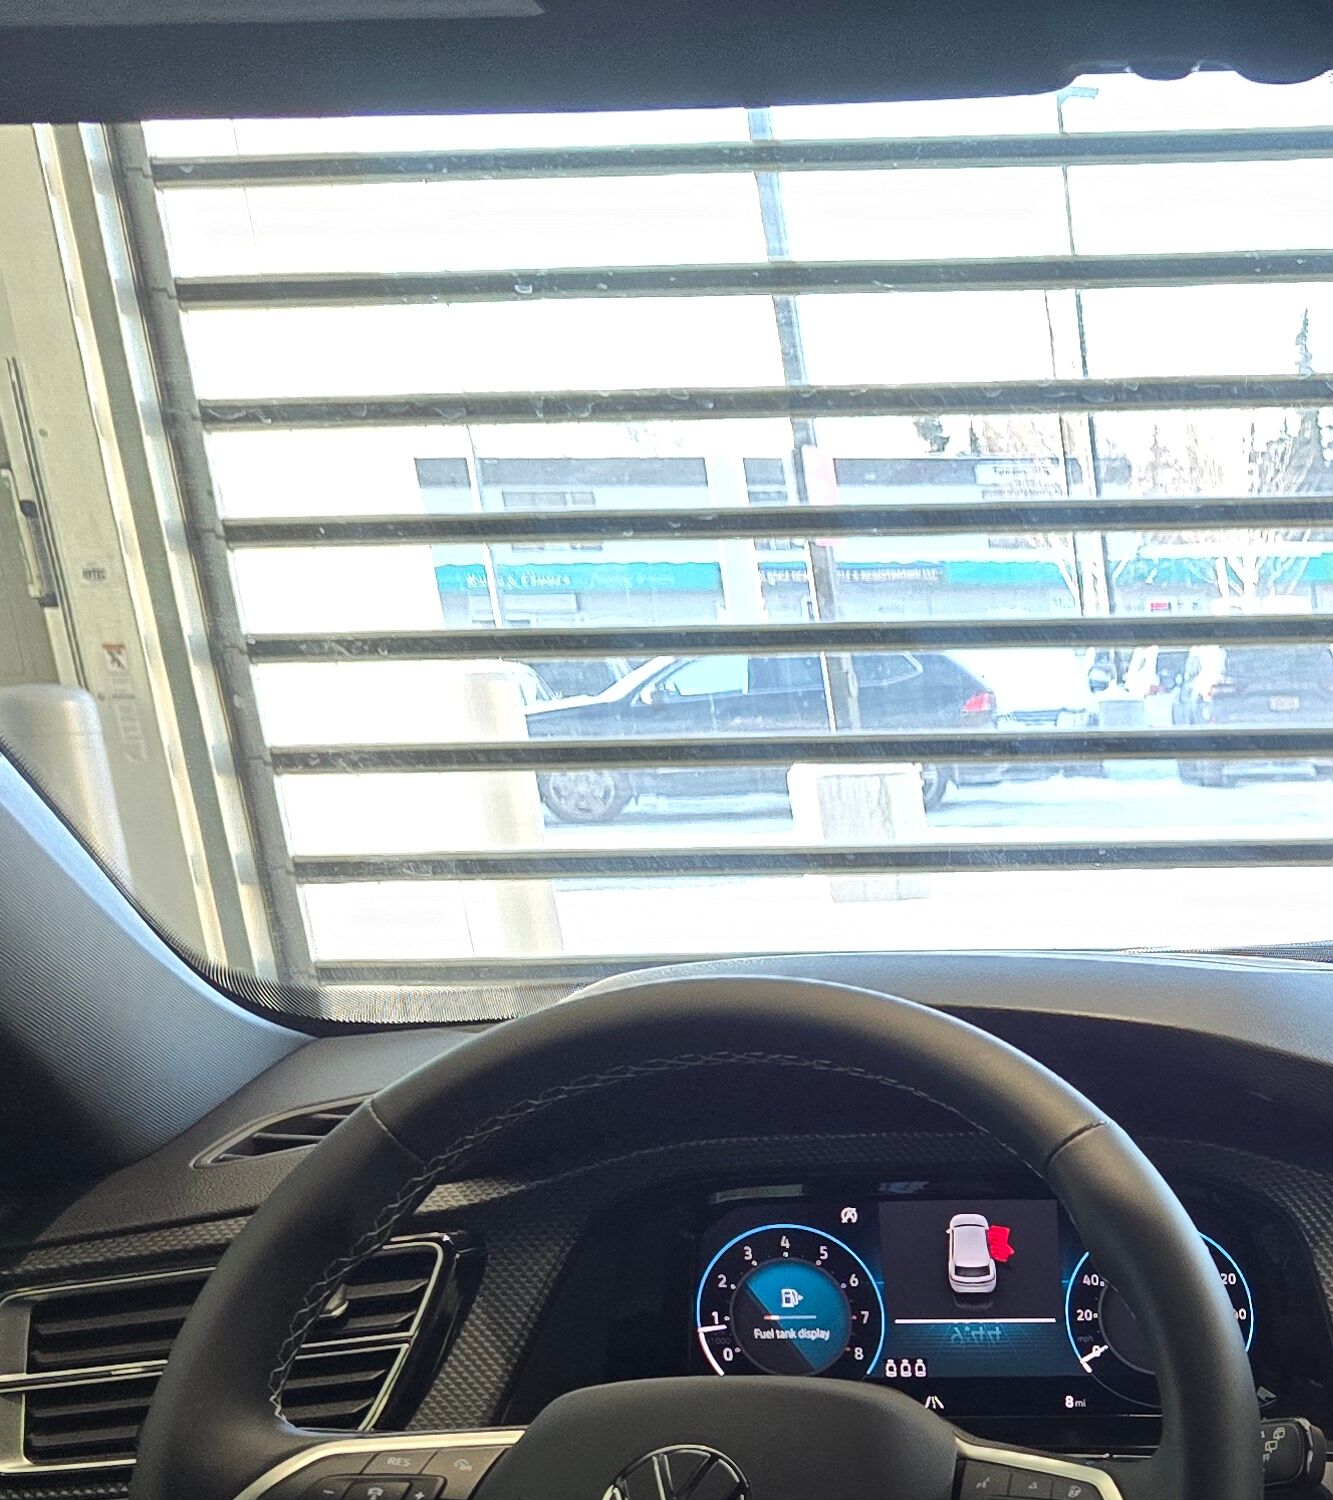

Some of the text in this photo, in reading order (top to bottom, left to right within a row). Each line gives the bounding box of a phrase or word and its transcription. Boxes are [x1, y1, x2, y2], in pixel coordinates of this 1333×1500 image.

[780, 1235, 790, 1249] 4
[743, 1245, 753, 1261] 3
[819, 1245, 829, 1260] 5
[717, 1274, 728, 1288] 2
[849, 1273, 859, 1287] 6
[1083, 1274, 1099, 1286] 40
[712, 1311, 719, 1325] 1
[861, 1310, 869, 1324] 7
[1076, 1309, 1093, 1321] 20
[754, 1328, 831, 1341] Fuel tank display
[722, 1348, 734, 1361] 0
[854, 1347, 864, 1360] 8
[1065, 1395, 1087, 1408] 8 mi
[387, 1457, 411, 1467] RES
